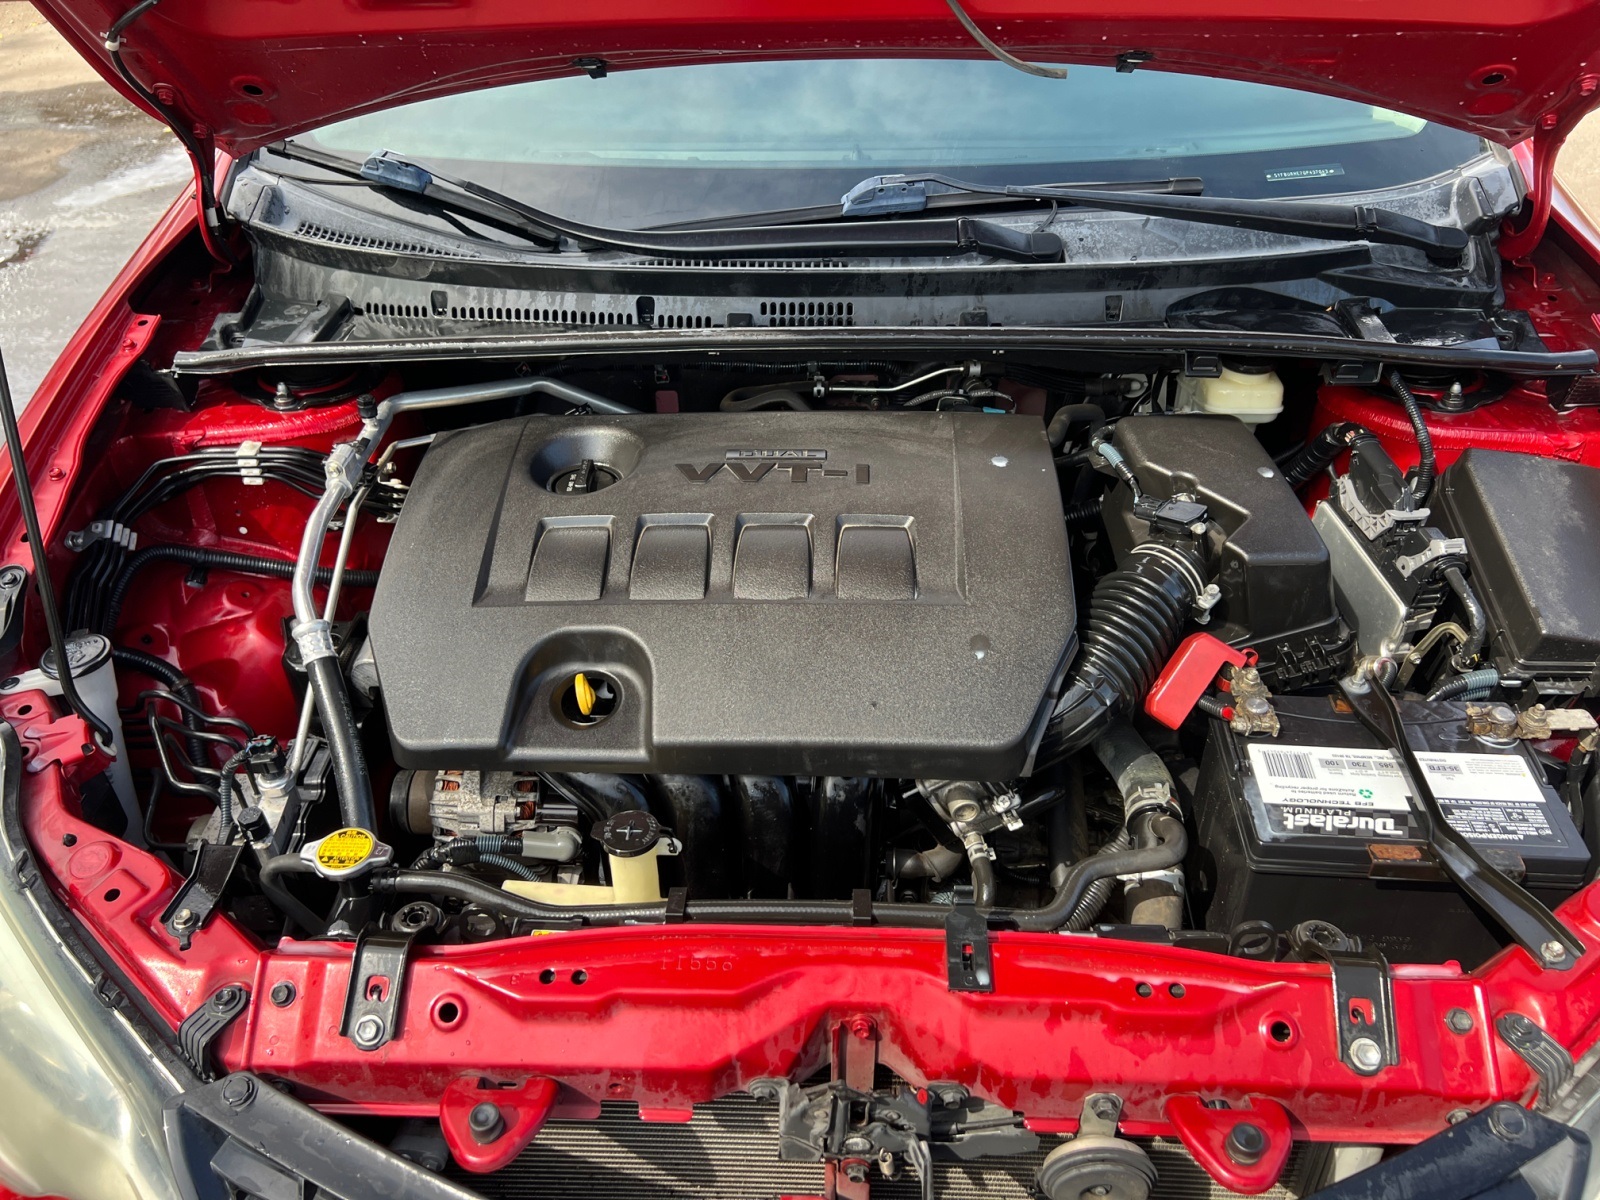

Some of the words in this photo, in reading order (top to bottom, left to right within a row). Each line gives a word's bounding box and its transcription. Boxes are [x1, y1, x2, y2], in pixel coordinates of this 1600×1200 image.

[739, 449, 817, 457] DUAL
[1428, 764, 1459, 772] 35-EFB
[1282, 797, 1351, 805] TECHNOLOGY
[1282, 813, 1403, 835] Duralast
